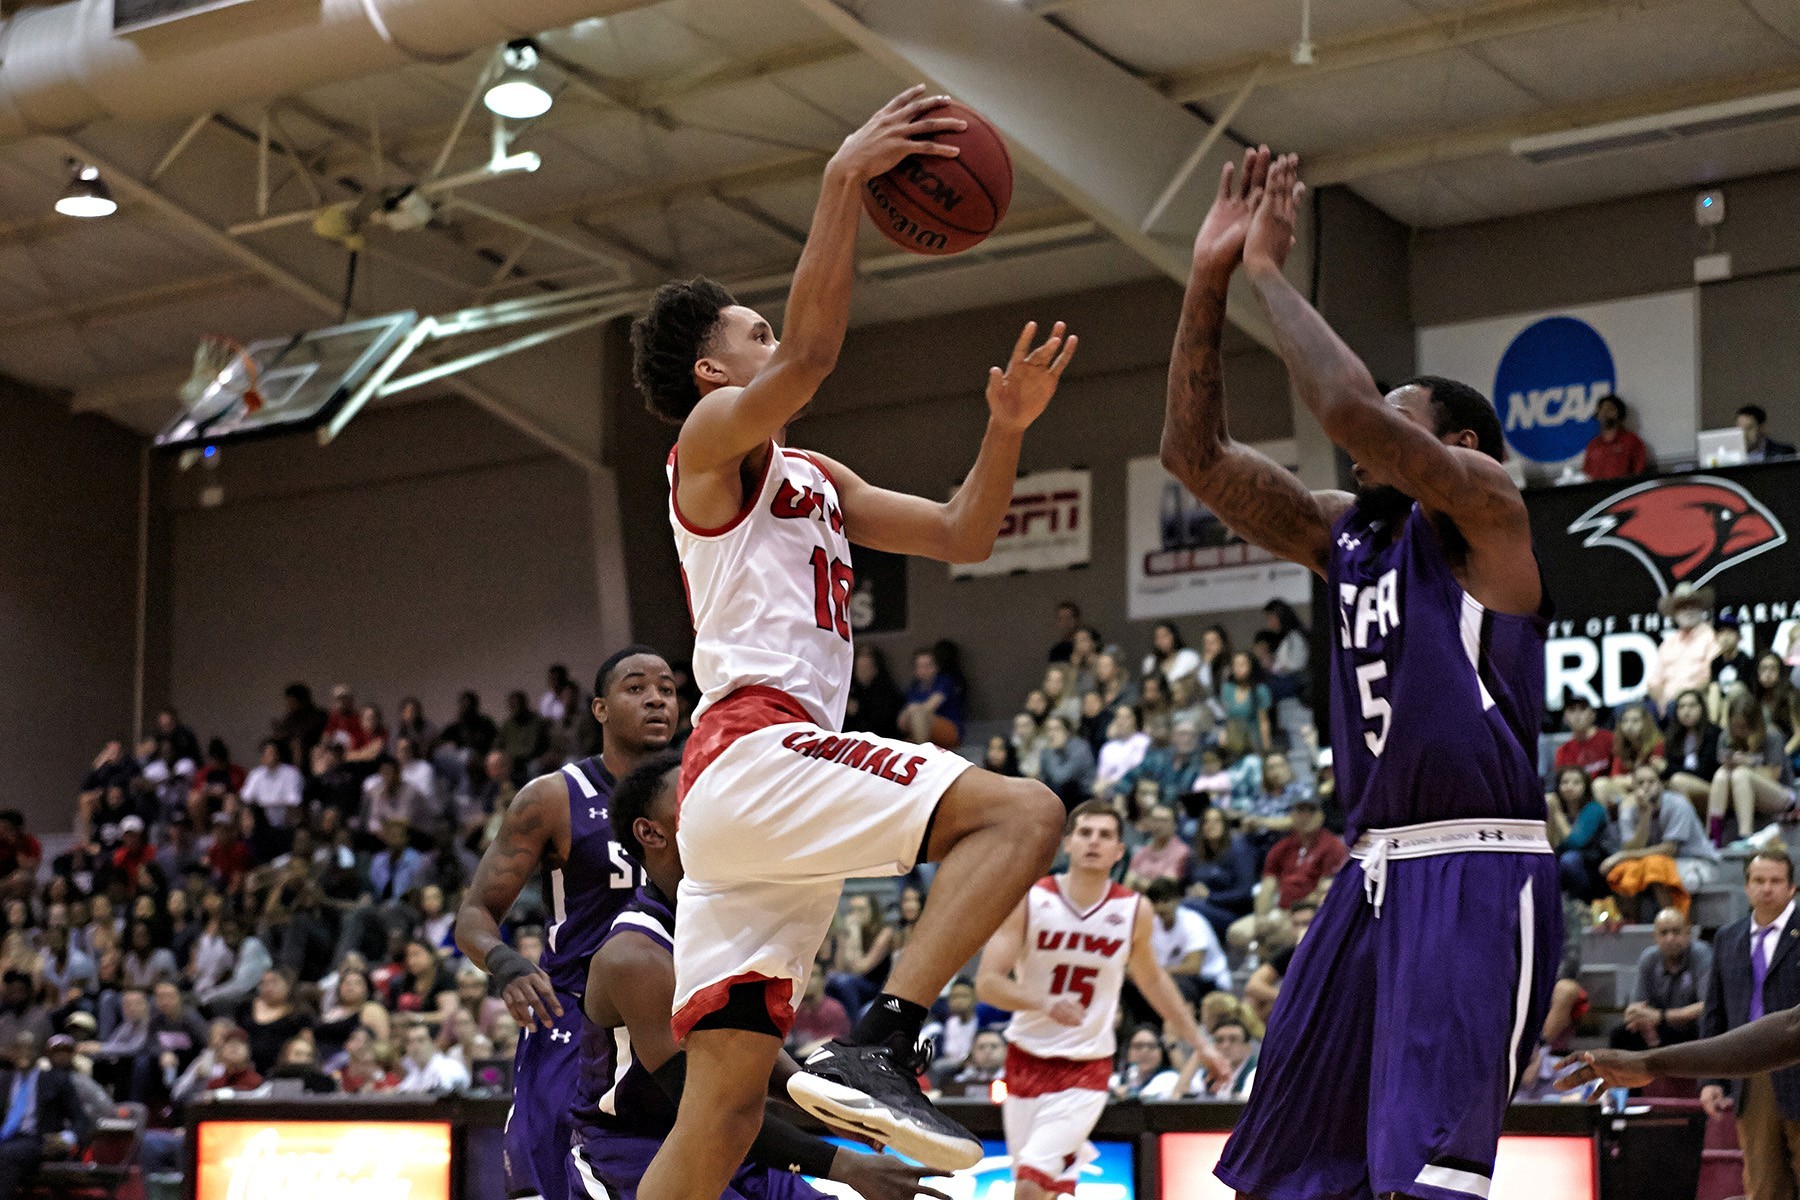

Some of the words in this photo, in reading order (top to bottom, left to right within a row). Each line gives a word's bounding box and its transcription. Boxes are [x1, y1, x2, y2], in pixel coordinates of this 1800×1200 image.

[998, 489, 1079, 538] SPN
[809, 545, 854, 643] 10
[1339, 568, 1400, 650] SFA
[1586, 615, 1617, 638] OF
[1355, 660, 1392, 758] 5
[782, 731, 927, 786] CARDINALS
[607, 840, 647, 889] S
[1037, 930, 1123, 958] UIW
[1049, 963, 1099, 1010] 15
